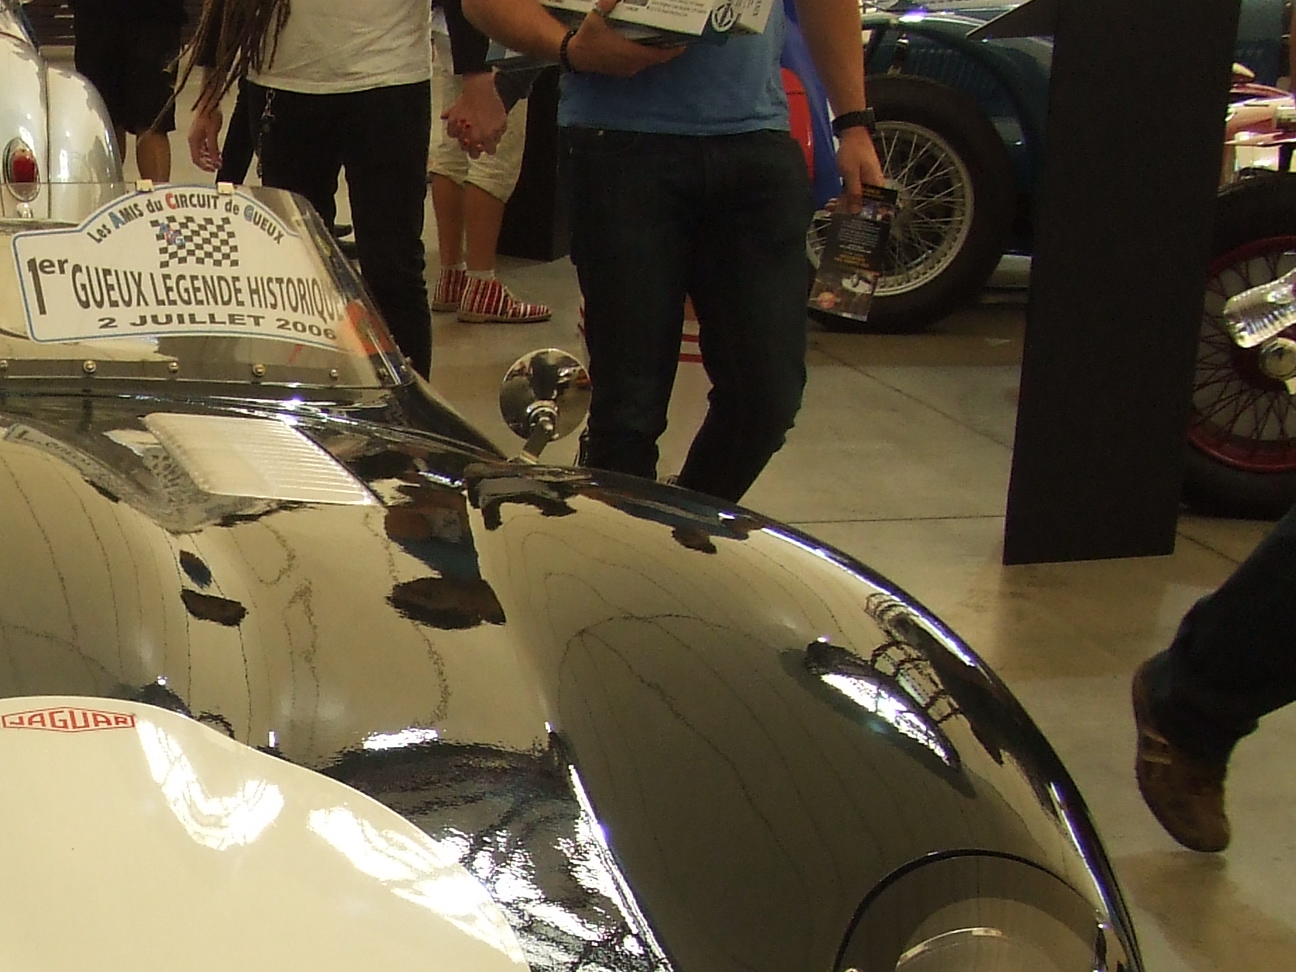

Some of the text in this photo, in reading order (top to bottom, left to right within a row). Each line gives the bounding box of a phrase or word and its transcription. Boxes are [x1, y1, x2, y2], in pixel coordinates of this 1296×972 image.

[86, 193, 285, 245] Les AMIS du CIRCUIT de GUEUX
[27, 257, 69, 316] 1er
[71, 264, 150, 310] GUEUX
[150, 272, 246, 308] LEGENDE
[98, 313, 337, 340] 2 JUILLET 2006
[9, 710, 129, 730] JAGUAR
